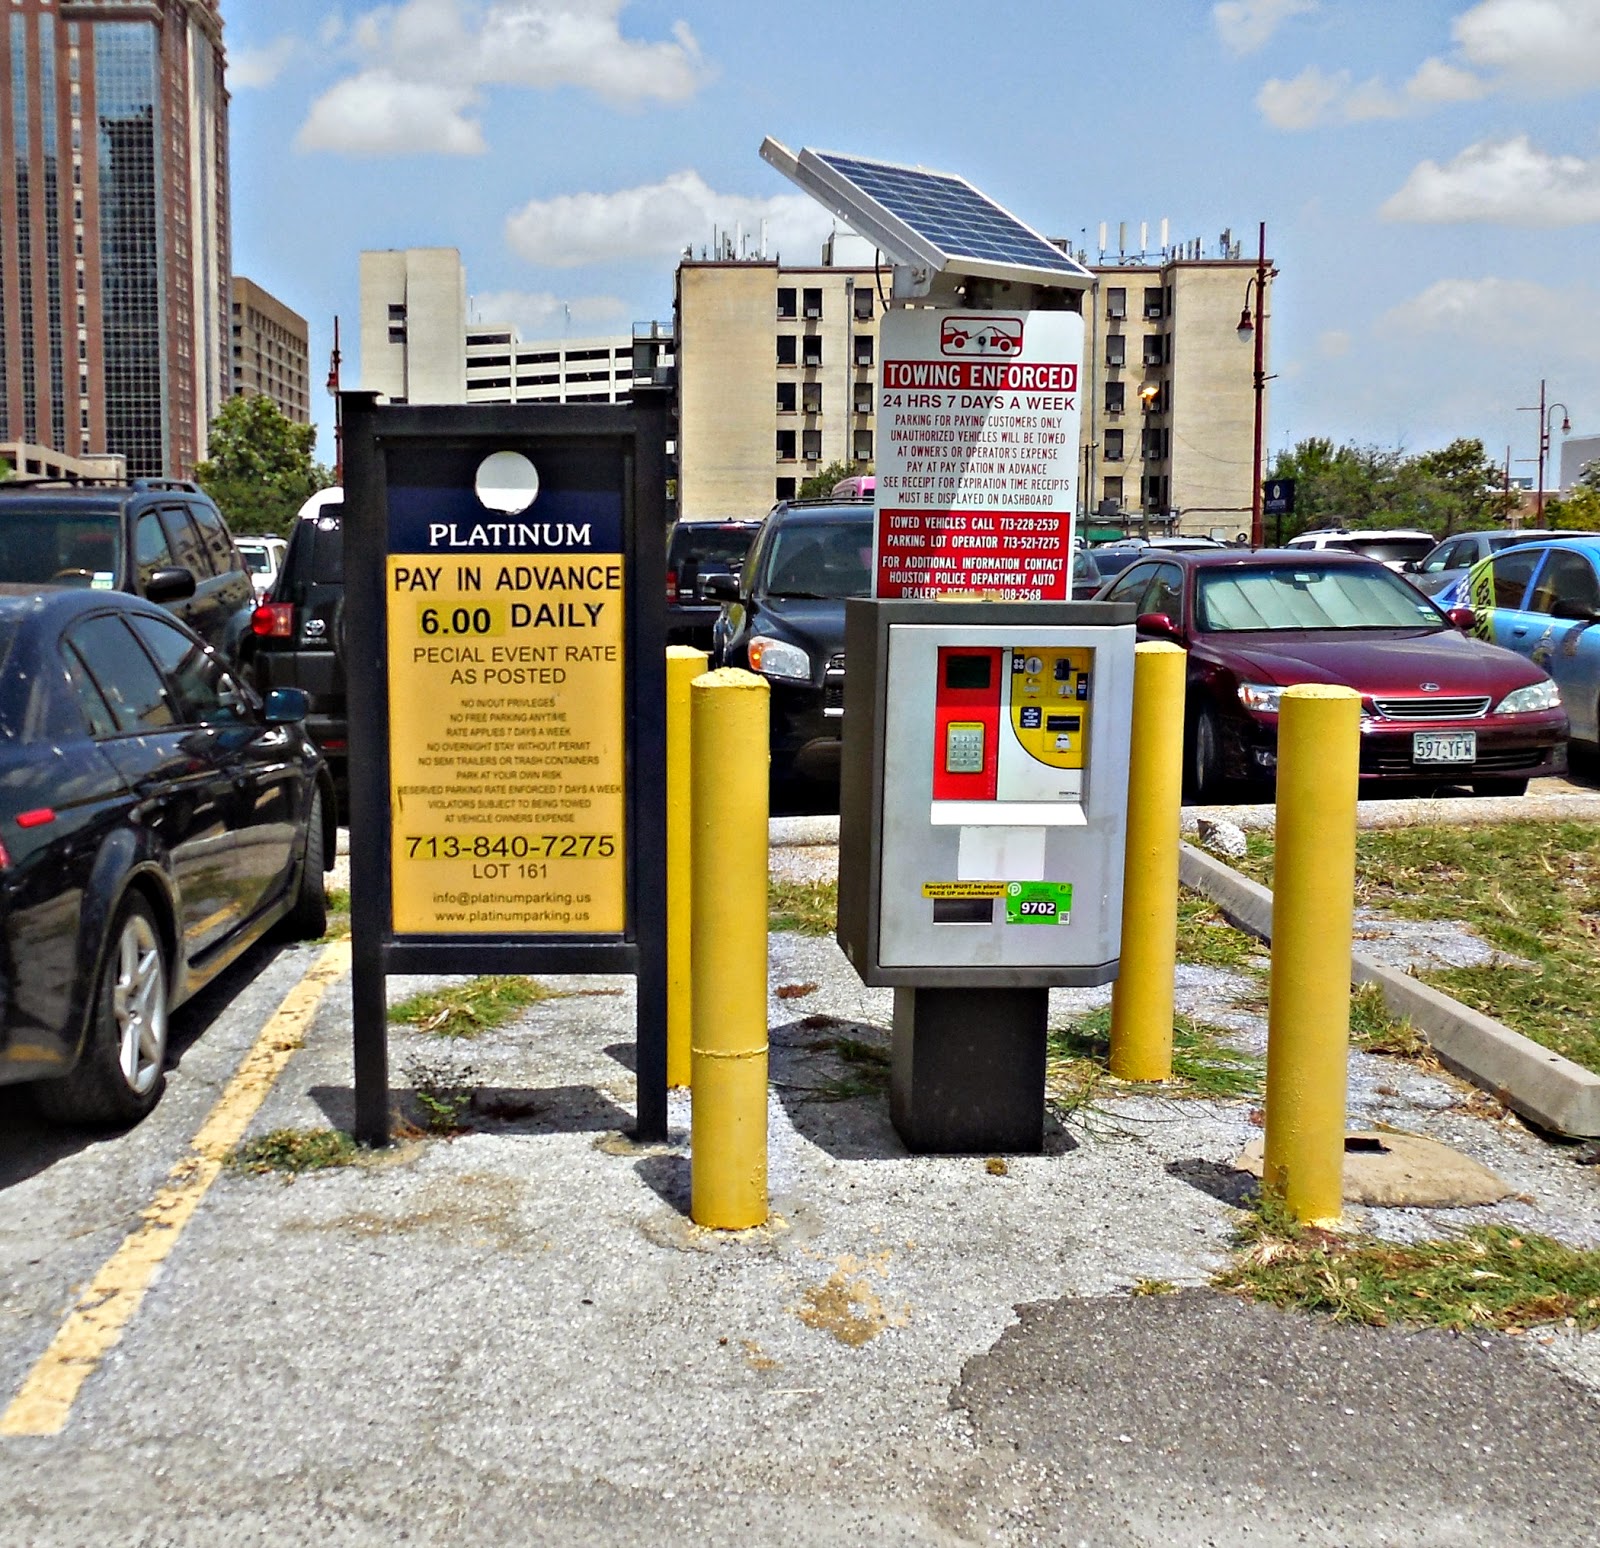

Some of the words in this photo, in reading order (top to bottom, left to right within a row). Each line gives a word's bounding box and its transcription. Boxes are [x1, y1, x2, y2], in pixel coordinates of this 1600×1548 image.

[888, 363, 960, 387] TOWING
[970, 365, 1074, 389] ENFORCED
[883, 394, 902, 408] 24
[907, 394, 942, 408] HRS
[947, 395, 956, 408] 7
[961, 395, 1004, 409] DAYS
[1009, 396, 1021, 410] A
[1026, 396, 1075, 411] WEEK
[895, 414, 932, 426] PARKING
[935, 414, 951, 427] FOR
[953, 415, 985, 427] PAYING
[988, 415, 1037, 428] CUSTOMERS
[1041, 416, 1062, 429] ONLY
[890, 430, 955, 442] UNAUTHORIZED
[958, 431, 998, 443] VEHICLES
[1001, 432, 1020, 443] WILL
[1023, 432, 1034, 443] BE
[1037, 432, 1066, 444] TOWED
[897, 445, 908, 457] AT
[911, 446, 948, 458] OWNER'S
[951, 446, 963, 458] OR
[966, 446, 1018, 459] OPERATOR'S
[1020, 447, 1058, 460] EXPENSE
[906, 461, 923, 473] PAY
[926, 462, 938, 473] AT
[940, 462, 956, 474] PAY
[960, 462, 994, 474] STATION
[997, 463, 1006, 475] IN
[1008, 463, 1047, 476] ADVANCE
[883, 476, 899, 488] SEE
[901, 476, 935, 488] RECEIPT
[938, 477, 955, 489] FOR
[958, 477, 1007, 490] EXPIRATION
[1010, 478, 1028, 490] TIME
[1031, 478, 1070, 491] RECEIPTS
[898, 492, 922, 504] MUST
[924, 492, 935, 504] BE
[937, 492, 985, 505] DISPLAYED
[987, 493, 998, 505] ON
[1001, 494, 1053, 506] DASHBOARD
[890, 515, 920, 529] TOWED
[925, 516, 966, 530] VEHICLES
[971, 517, 995, 530] CALL
[1000, 517, 1060, 532] 713-228-2539
[429, 523, 592, 547] PLATINUM
[887, 534, 926, 547] PARKING
[930, 535, 947, 548] LOT
[952, 535, 998, 549] OPERATOR
[1003, 536, 1060, 550] 713-521-7275
[882, 555, 900, 568] FOR
[905, 556, 957, 569] ADDITIONAL
[962, 557, 1020, 571] INFORMATION
[1024, 558, 1064, 571] CONTACT
[394, 567, 442, 592] PAY
[457, 567, 481, 591] IN
[495, 565, 621, 591] ADVANCE
[889, 571, 930, 583] HOUSTON
[935, 572, 966, 585] POLICE
[971, 573, 1027, 586] DEPARTMENT
[1031, 574, 1055, 586] AUTO
[421, 608, 491, 634] 6.00
[511, 602, 605, 628] DAILY
[414, 646, 485, 663] PECIAL
[492, 646, 559, 662] EVENT
[565, 645, 617, 662] RATE
[450, 668, 477, 685] AS
[484, 668, 566, 685] POSTED
[461, 699, 474, 708] NO
[507, 698, 556, 708] PRIVILEGES
[450, 713, 464, 722] NO
[465, 713, 487, 722] FREE
[490, 713, 527, 722] PARKING
[529, 712, 567, 722] ANYTIME
[446, 728, 468, 737] RATE
[470, 728, 506, 737] APPLIES
[507, 728, 513, 736] 7
[514, 728, 537, 737] DAYS
[538, 728, 544, 736] A
[546, 728, 571, 736] WEEK
[427, 743, 440, 752] NO
[441, 742, 492, 752] OVERNIGHT
[494, 742, 515, 751] STAY
[518, 742, 557, 751] WITHOUT
[559, 741, 590, 751] PERMIT
[418, 757, 432, 766] NO
[434, 757, 455, 766] SEMI
[456, 756, 497, 766] TRAILERS
[499, 756, 512, 766] OR
[514, 756, 543, 765] TRASH
[544, 756, 600, 765] CONTAINERS
[456, 771, 478, 780] PARK
[480, 771, 491, 779] AT
[493, 770, 517, 779] YOUR
[520, 770, 540, 779] OWN
[542, 770, 562, 779] RISK
[445, 785, 483, 794] PARKING
[484, 785, 506, 794] RATE
[508, 785, 556, 794] ENFORCED
[558, 785, 563, 793] 7
[564, 785, 587, 793] DAYS
[589, 785, 595, 793] A
[596, 784, 622, 793] WEEK
[427, 800, 475, 809] VIOLATORS
[478, 799, 515, 809] SUBJECT
[517, 799, 530, 808] TO
[531, 799, 558, 808] BEING
[560, 799, 592, 808] TOWED
[444, 814, 454, 823] AT
[457, 814, 493, 823] VEHICLE
[535, 814, 575, 823] EXPENSE
[406, 835, 615, 858] 713-840-7275
[472, 863, 511, 879] LOT
[518, 863, 548, 879] 161
[433, 892, 592, 907] info@platinumparking.us
[1021, 902, 1056, 915] 9702
[435, 911, 590, 924] www.platinumparking.us
